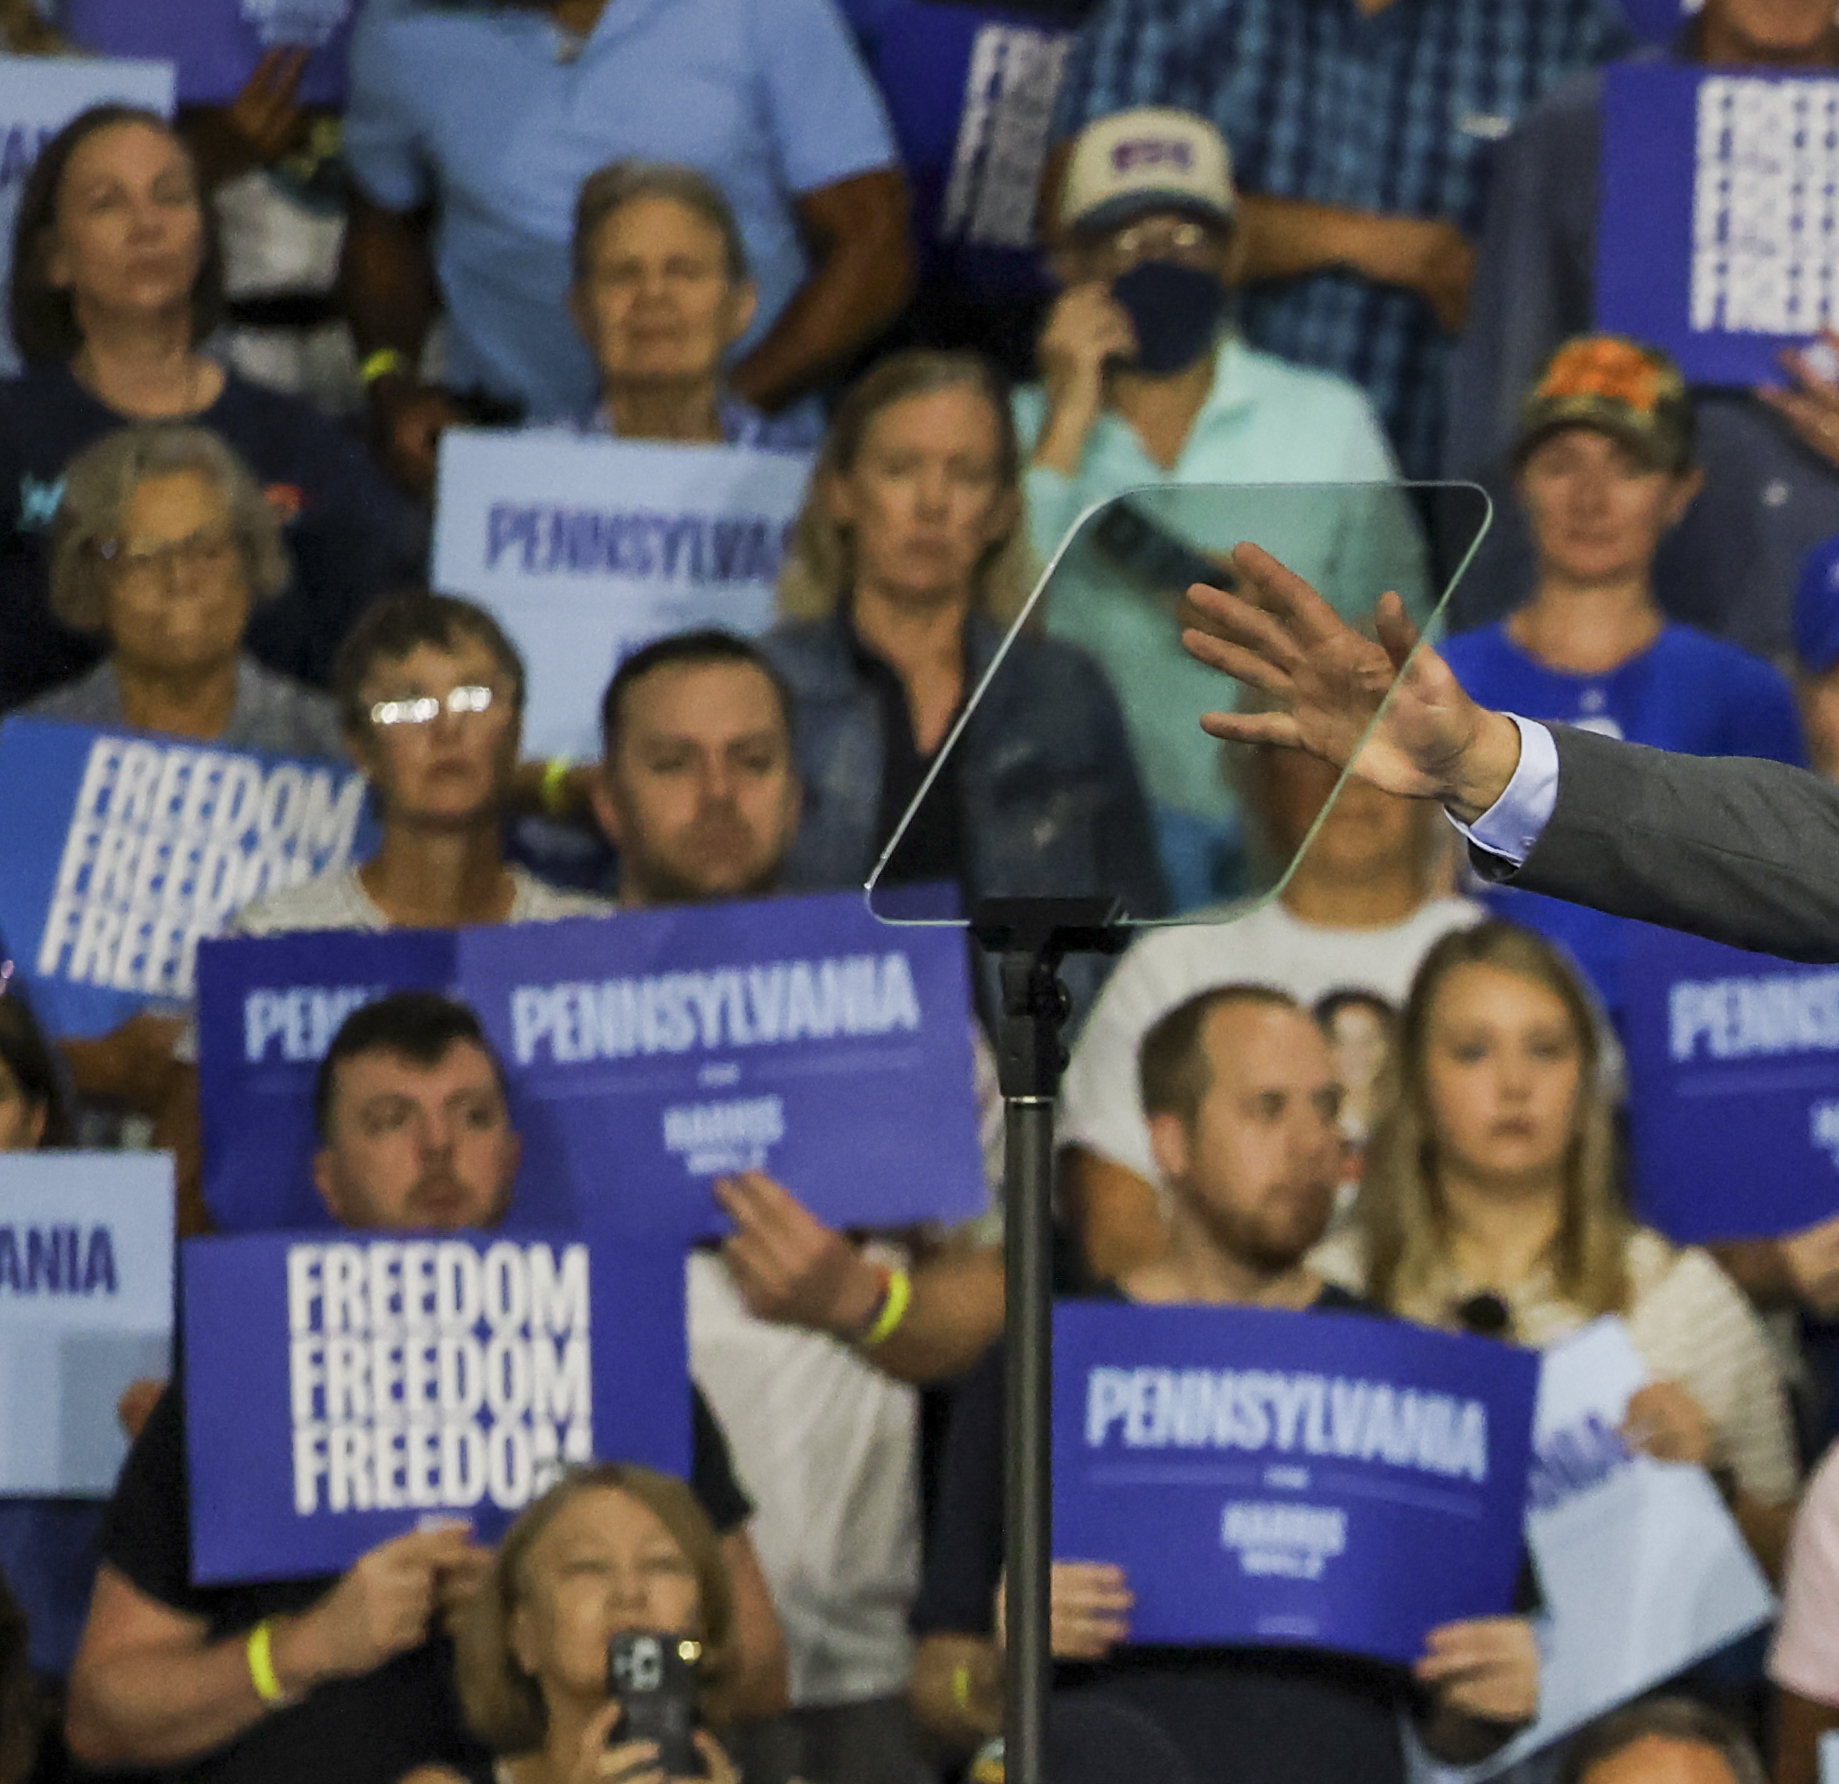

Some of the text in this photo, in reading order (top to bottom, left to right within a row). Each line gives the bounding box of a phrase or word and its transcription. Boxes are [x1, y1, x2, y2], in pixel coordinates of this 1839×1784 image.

[74, 737, 365, 868] FREEDOM
[55, 820, 312, 935] FREEDO
[512, 950, 918, 1066] PENNSYLVANIA
[287, 1240, 590, 1334] FREEDOM
[290, 1329, 592, 1421] FREEDOM
[1086, 1366, 1490, 1483] PENNSYLVANIA
